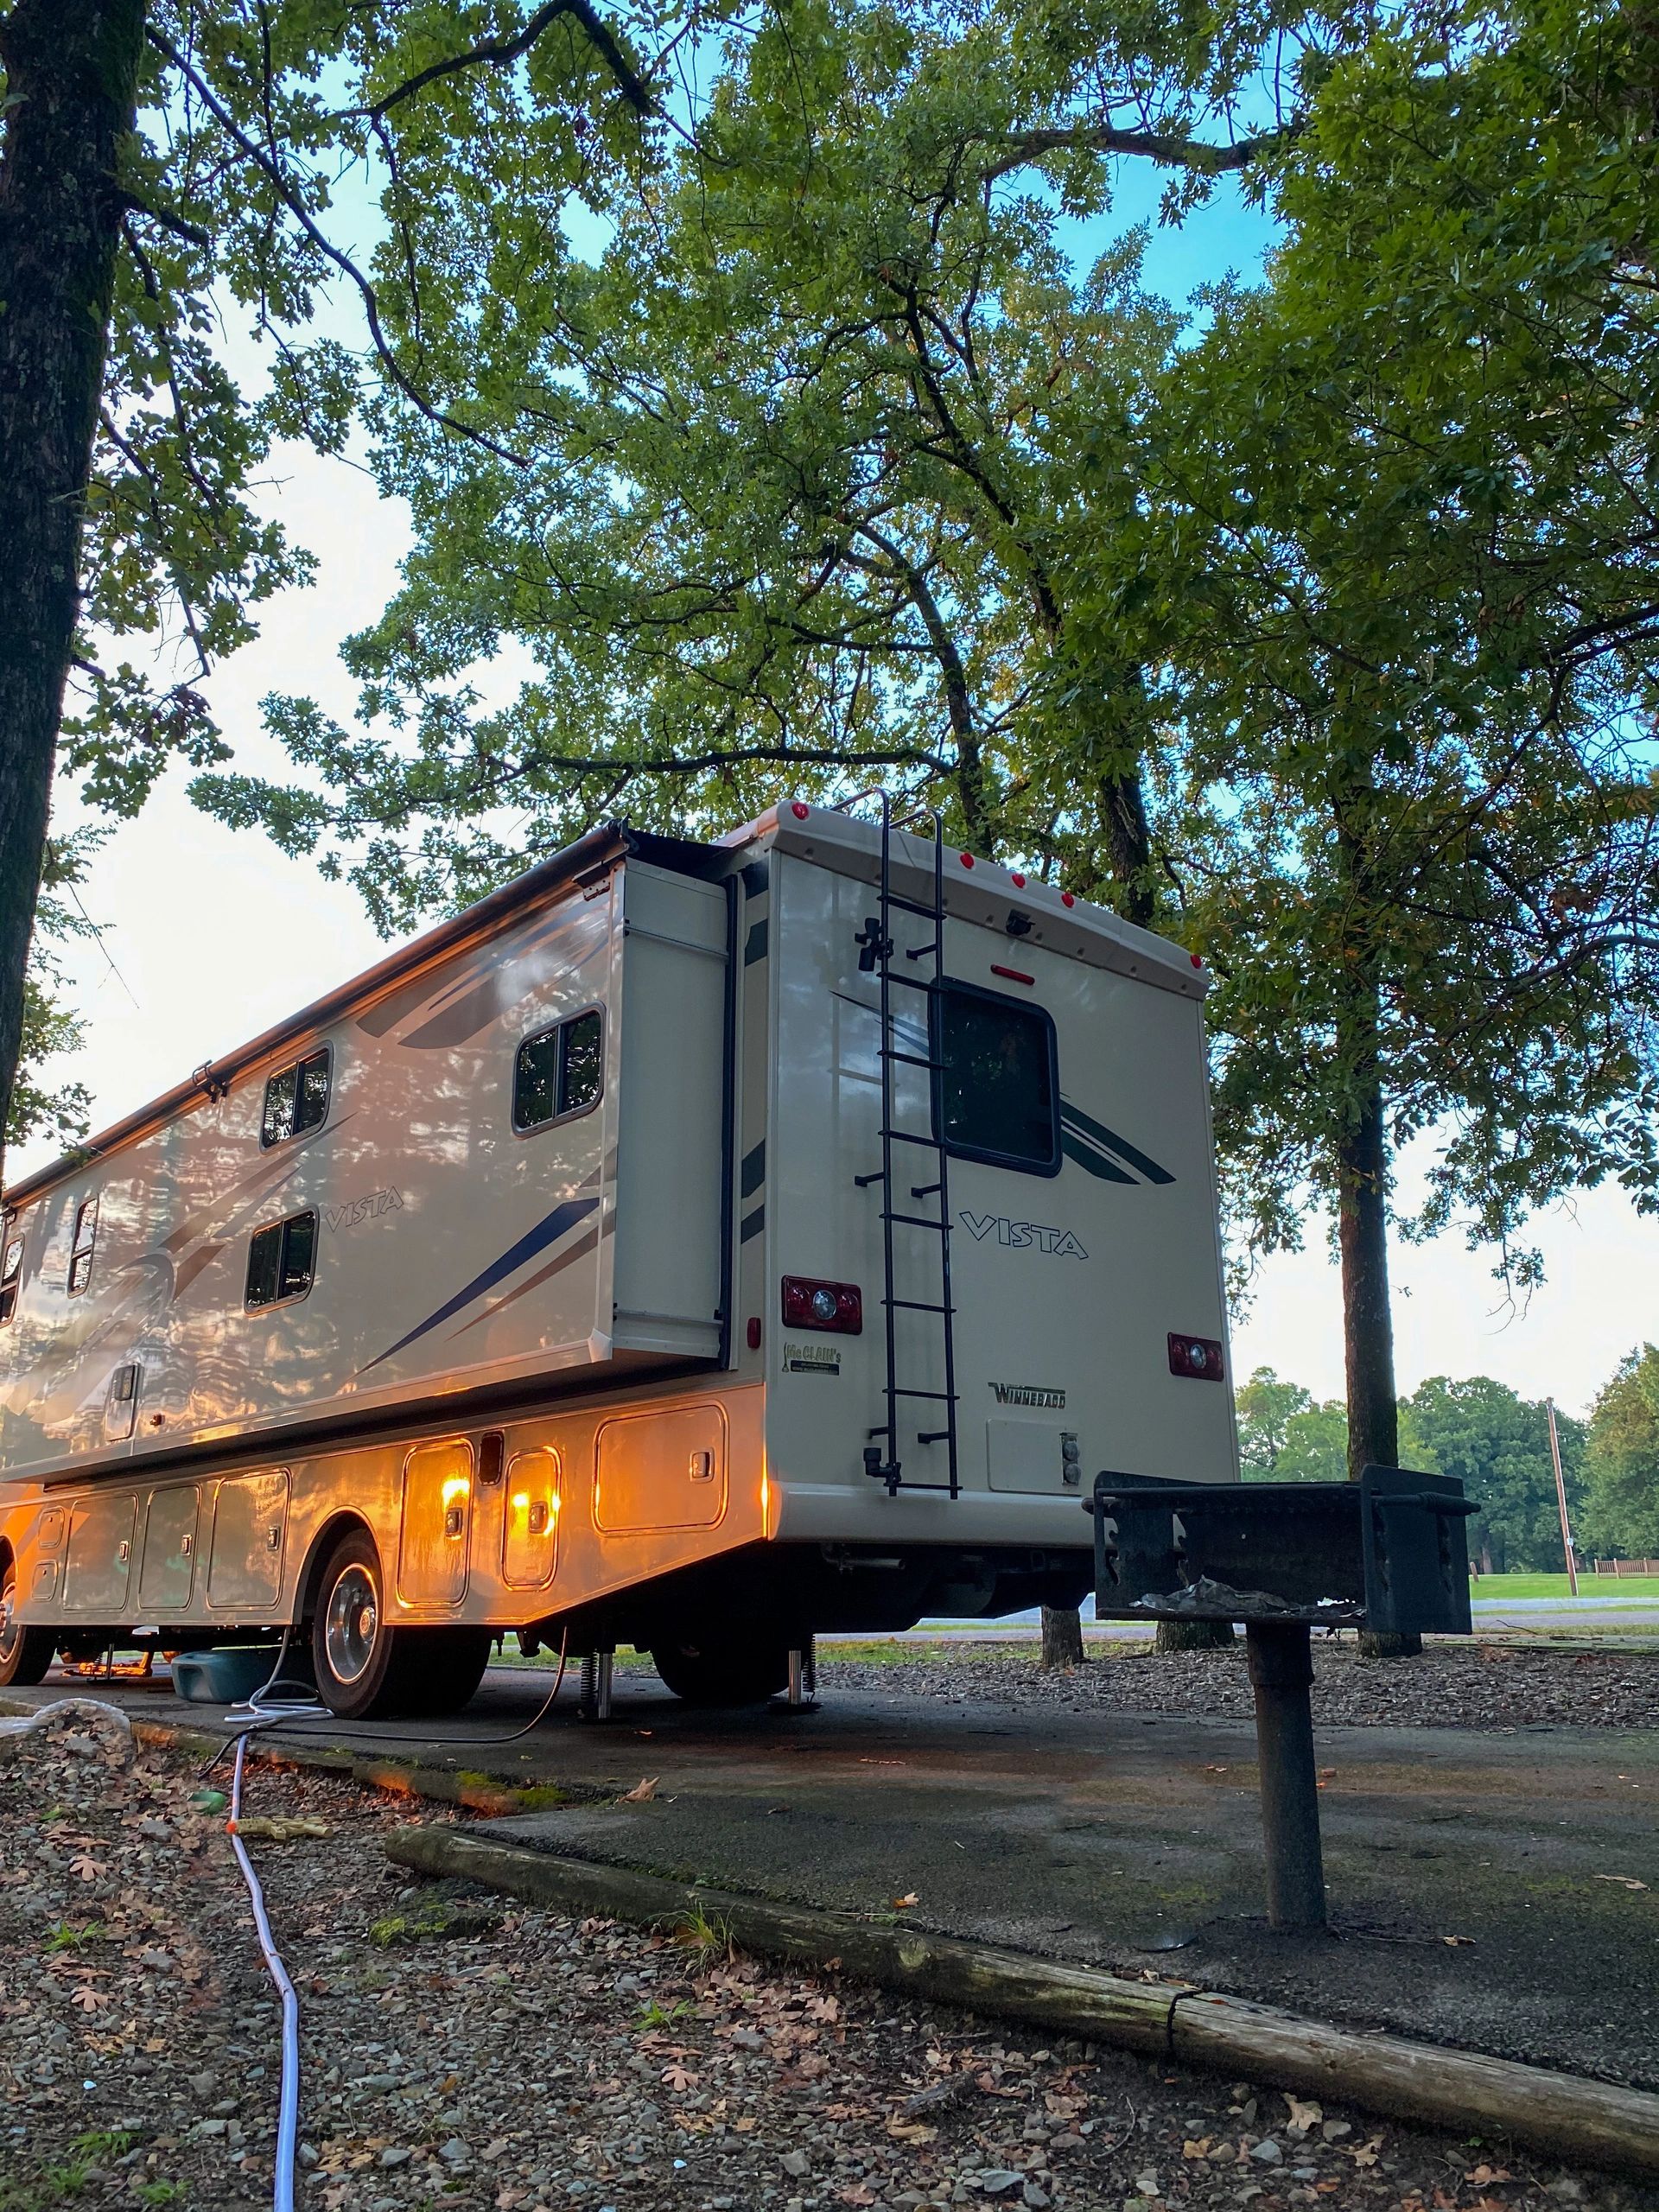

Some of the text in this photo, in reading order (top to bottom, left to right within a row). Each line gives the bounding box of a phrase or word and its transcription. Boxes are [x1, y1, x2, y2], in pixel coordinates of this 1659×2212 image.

[325, 1185, 404, 1233] VISTA
[959, 1211, 1089, 1260] VISTA
[988, 1382, 1066, 1409] WINNEBAGO
